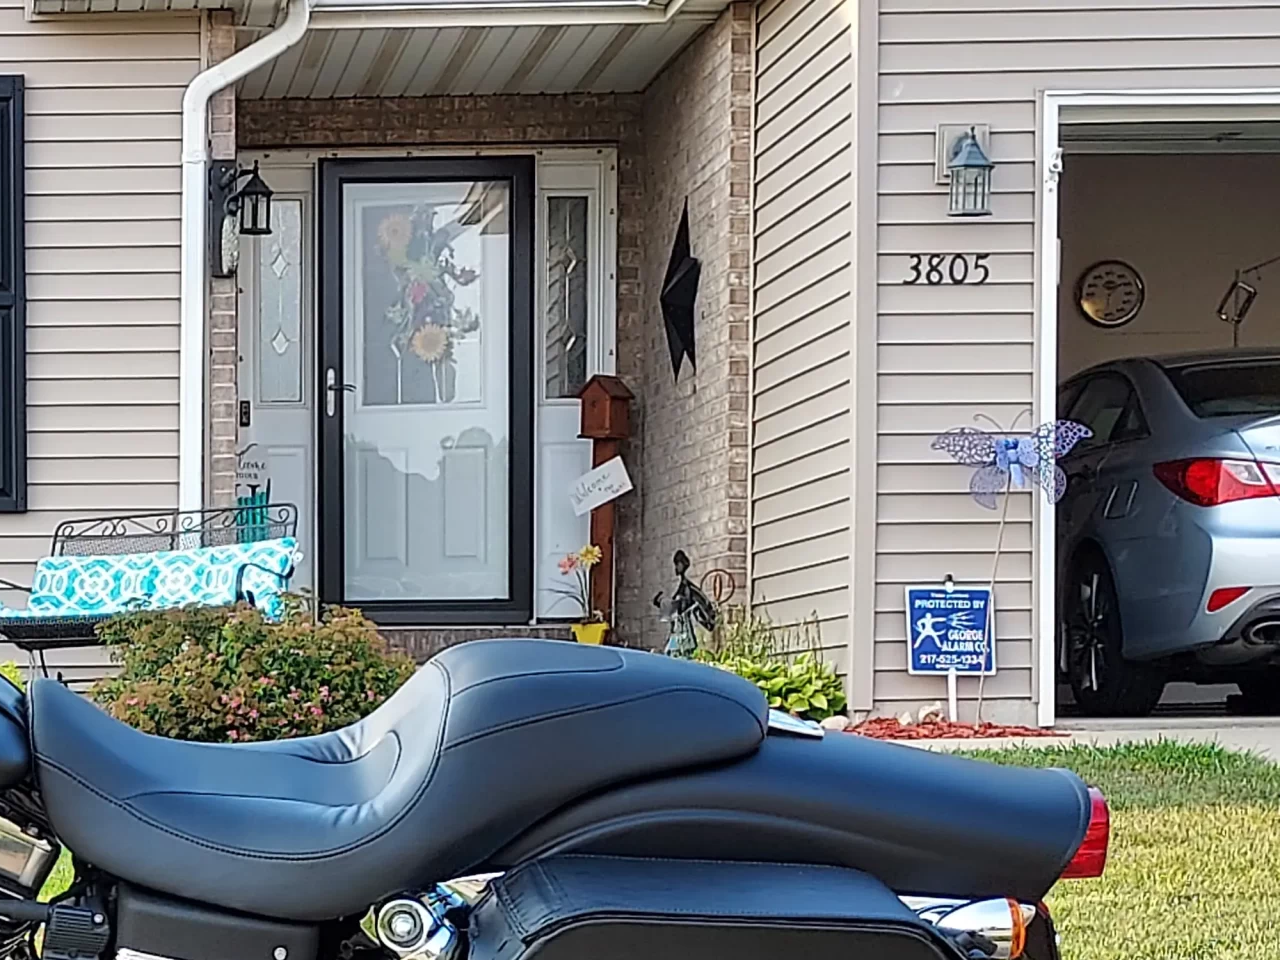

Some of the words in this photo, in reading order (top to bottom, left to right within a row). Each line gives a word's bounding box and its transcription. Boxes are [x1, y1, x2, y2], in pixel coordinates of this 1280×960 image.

[902, 253, 990, 285] 3805
[914, 599, 971, 609] PROTECTED
[972, 599, 985, 609] BY
[947, 629, 983, 641] GEORGE
[941, 641, 974, 652] ALARM
